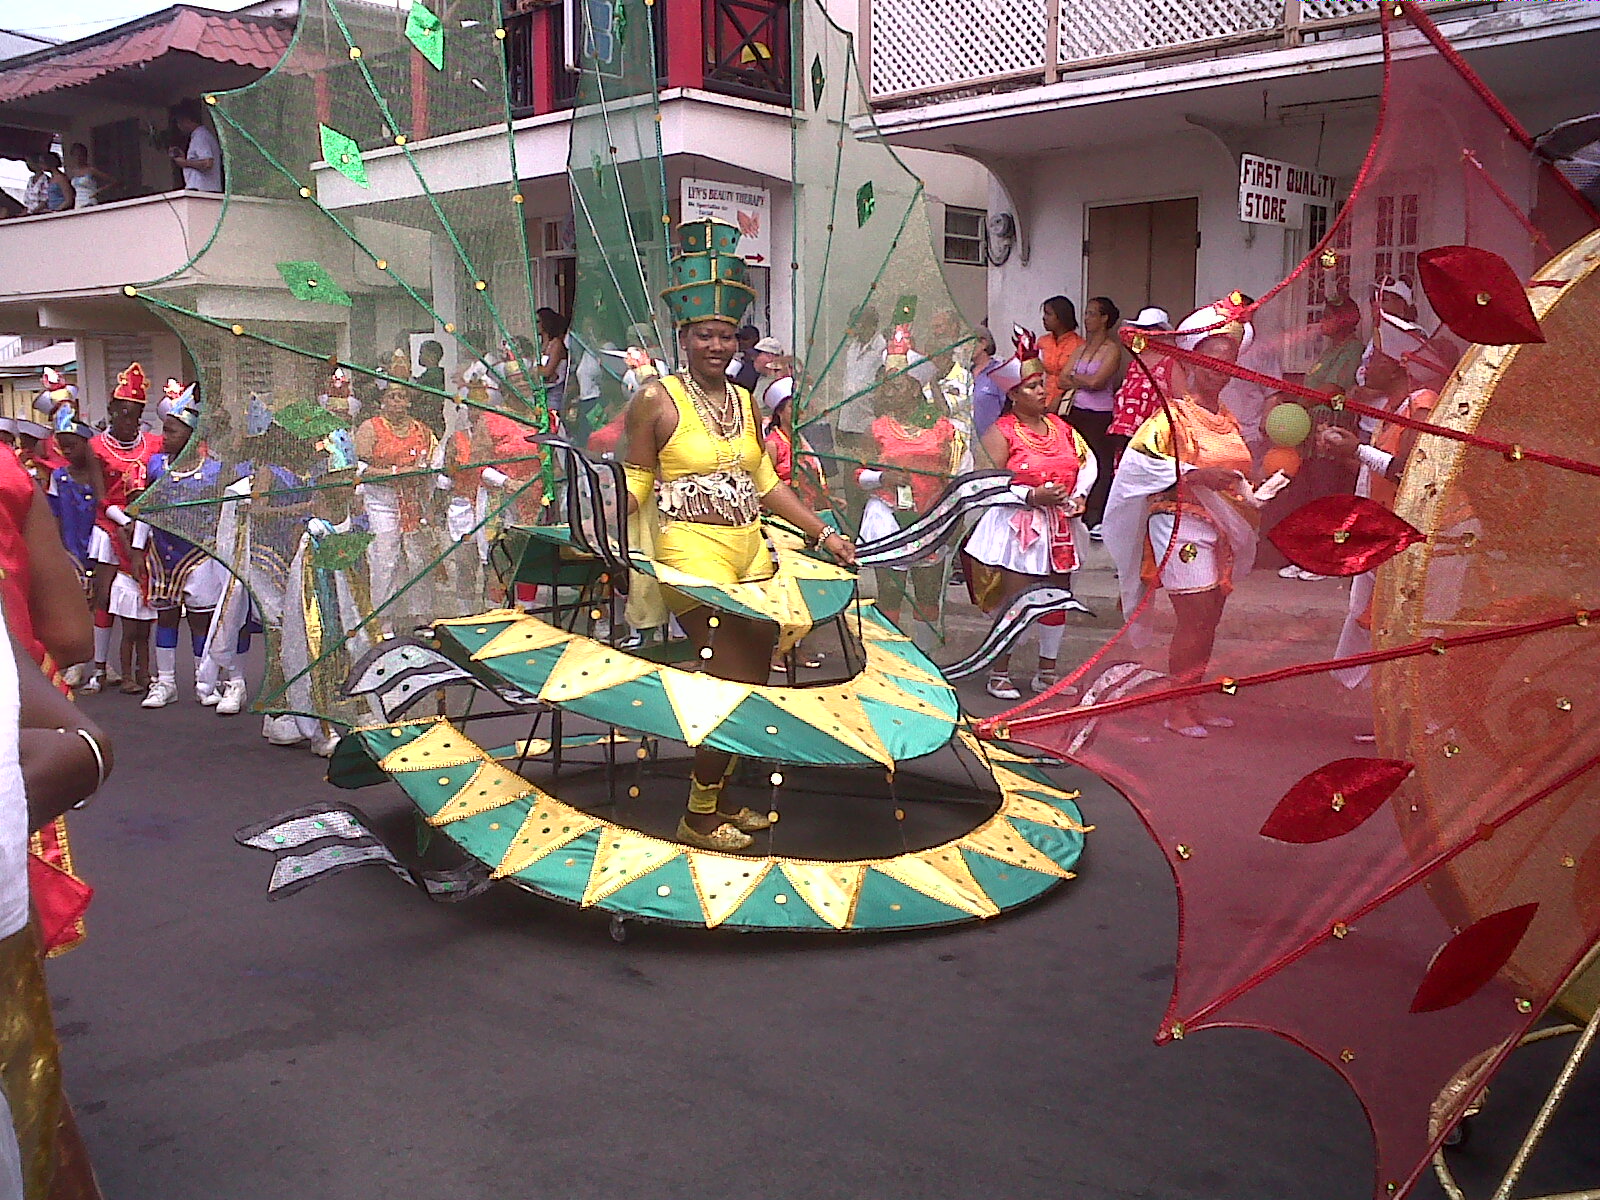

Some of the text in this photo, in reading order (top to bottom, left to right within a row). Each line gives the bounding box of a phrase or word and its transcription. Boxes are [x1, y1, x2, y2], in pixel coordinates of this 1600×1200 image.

[709, 188, 734, 201] BEAUTY
[736, 192, 766, 206] THERAPY
[1245, 192, 1287, 223] STORE
